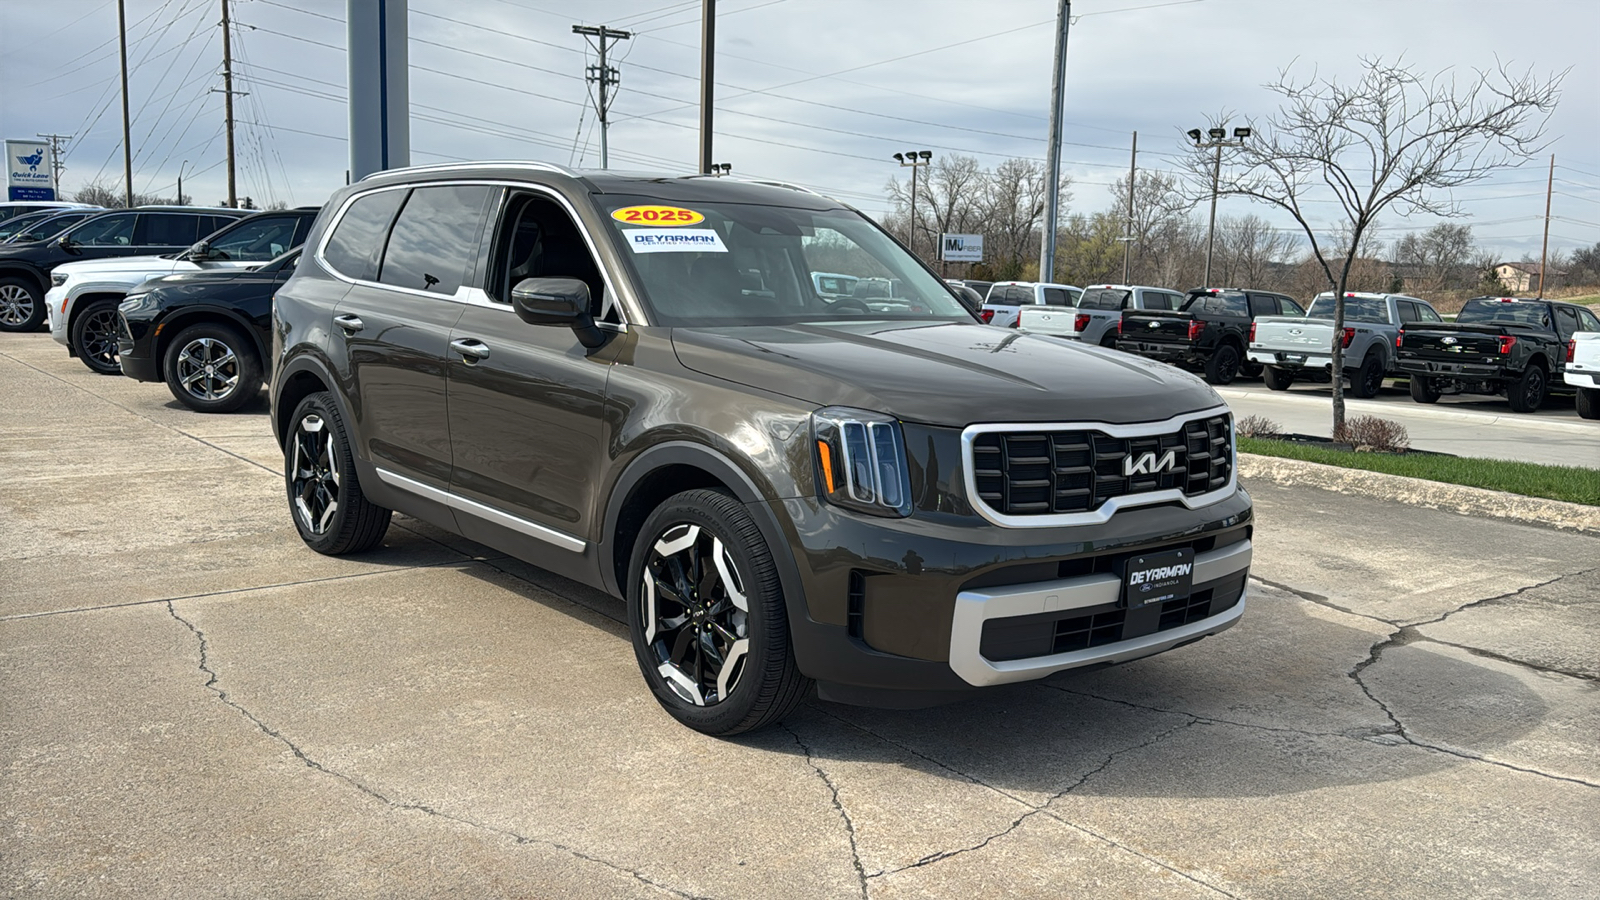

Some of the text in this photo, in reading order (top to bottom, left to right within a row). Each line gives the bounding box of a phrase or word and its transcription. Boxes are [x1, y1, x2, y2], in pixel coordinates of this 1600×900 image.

[625, 210, 693, 221] 2025
[945, 239, 964, 251] IMU
[1123, 450, 1175, 476] KIA
[1130, 563, 1192, 585] DEYARMAN
[1154, 580, 1180, 588] INDIANOLA
